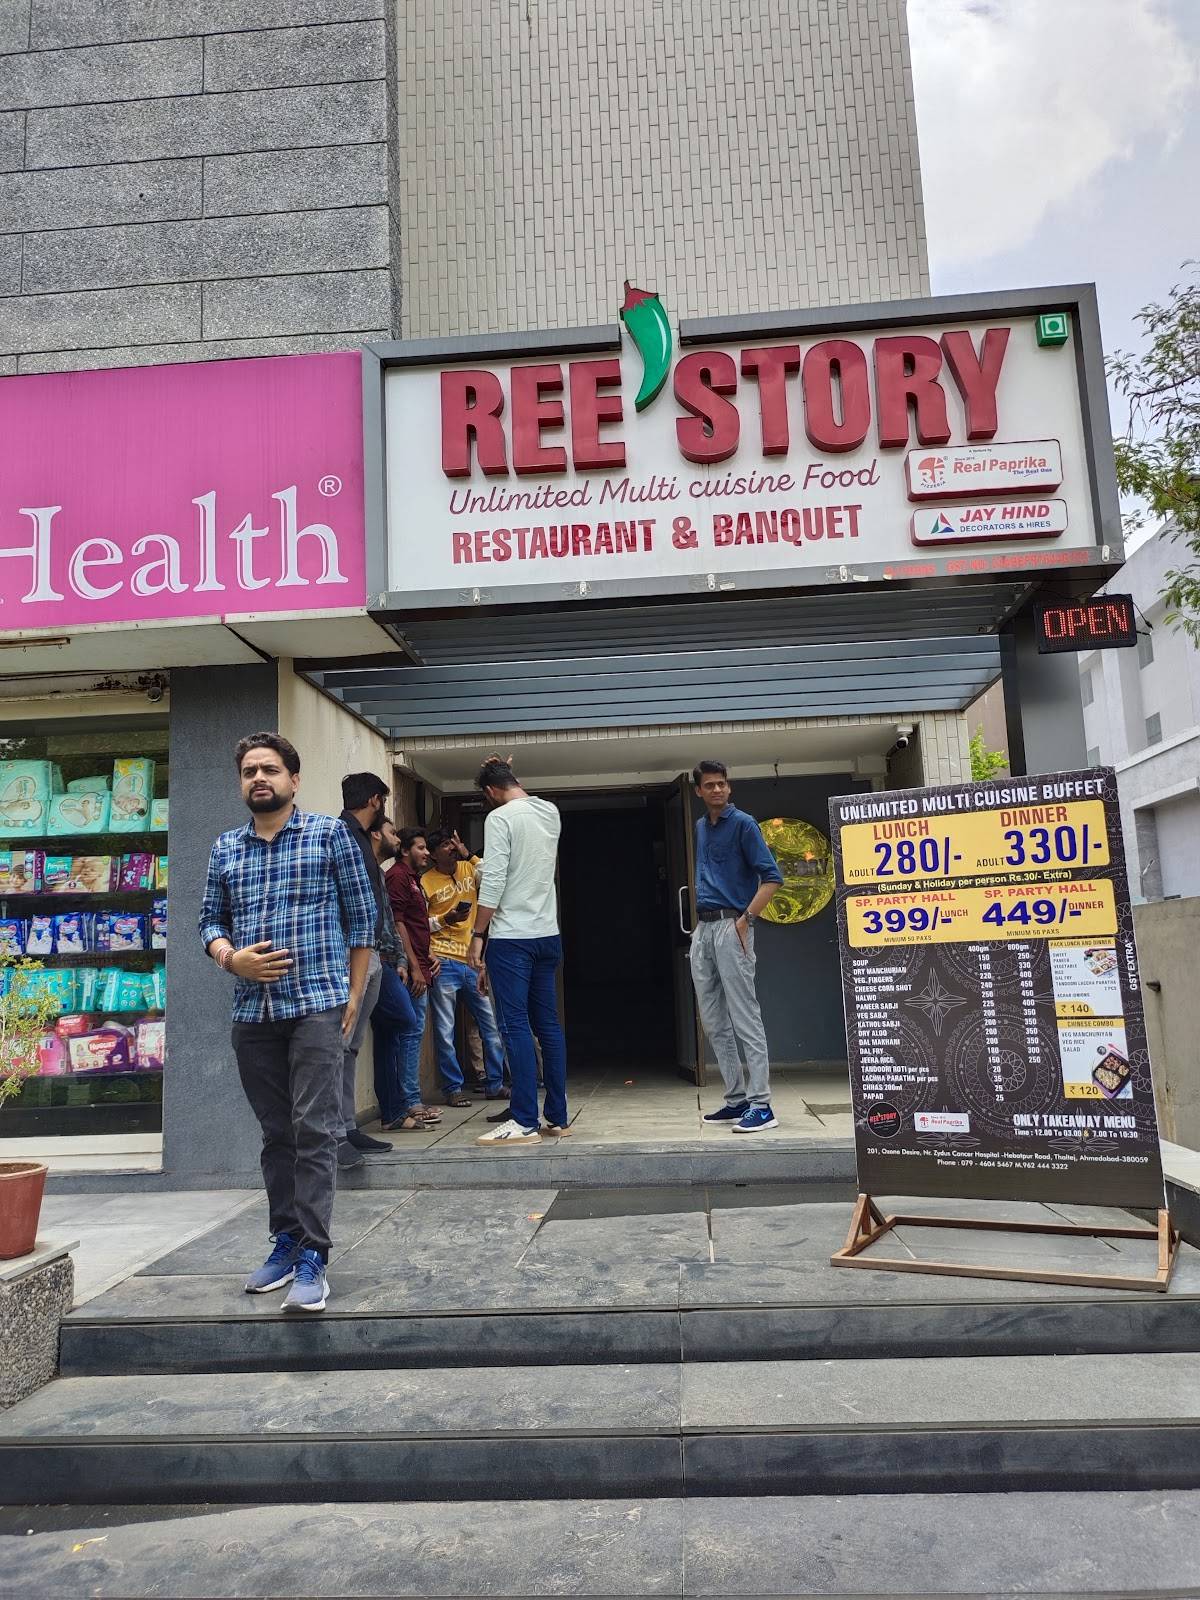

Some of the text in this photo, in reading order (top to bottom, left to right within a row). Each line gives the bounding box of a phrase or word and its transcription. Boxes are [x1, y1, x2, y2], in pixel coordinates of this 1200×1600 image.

[953, 456, 1047, 474] Real Paprika
[448, 460, 880, 515] Unlimited Multi cuisine Food
[960, 504, 1050, 523] JAY HIND
[452, 504, 863, 564] RESTAURANT & BANQUET
[960, 520, 1051, 532] DECORATORS HIRES
[0, 485, 349, 604] Health
[1043, 604, 1128, 638] OPEN
[840, 778, 1104, 821] UNLIMITED MULTI CUISINE BUFFET
[1000, 806, 1068, 827] DINNER
[873, 820, 930, 840] LUNCH
[976, 824, 1102, 868] ADULT 330/-
[849, 836, 962, 878] ADULT 280/-
[878, 882, 912, 893] (Sunday
[922, 878, 956, 890] Holiday
[958, 878, 972, 888] per
[974, 876, 1007, 886] person
[1009, 872, 1042, 881] Rs.30/-
[1043, 870, 1072, 880] Extra)
[855, 892, 956, 908] SP. PARTY HALL
[984, 883, 1097, 899] SP. PARTY HALL
[862, 906, 969, 934] 399/- LUNCH
[982, 898, 1104, 927] 449/- DINNER
[853, 968, 866, 976] DRY
[868, 976, 893, 984] FINGERS
[980, 972, 991, 980] 220
[1128, 972, 1138, 990] GST
[1071, 1004, 1089, 1013] 140
[882, 1020, 900, 1028] SABJI
[995, 1094, 1004, 1102] 25
[1080, 1086, 1098, 1095] 120
[1013, 1114, 1136, 1129] ONLY TAKEAWAY MENU
[1014, 1128, 1030, 1136] Time
[975, 1151, 1000, 1159] Hospital
[1034, 1153, 1053, 1161] Road,
[1080, 1155, 1149, 1163] Ahmedabad-380059
